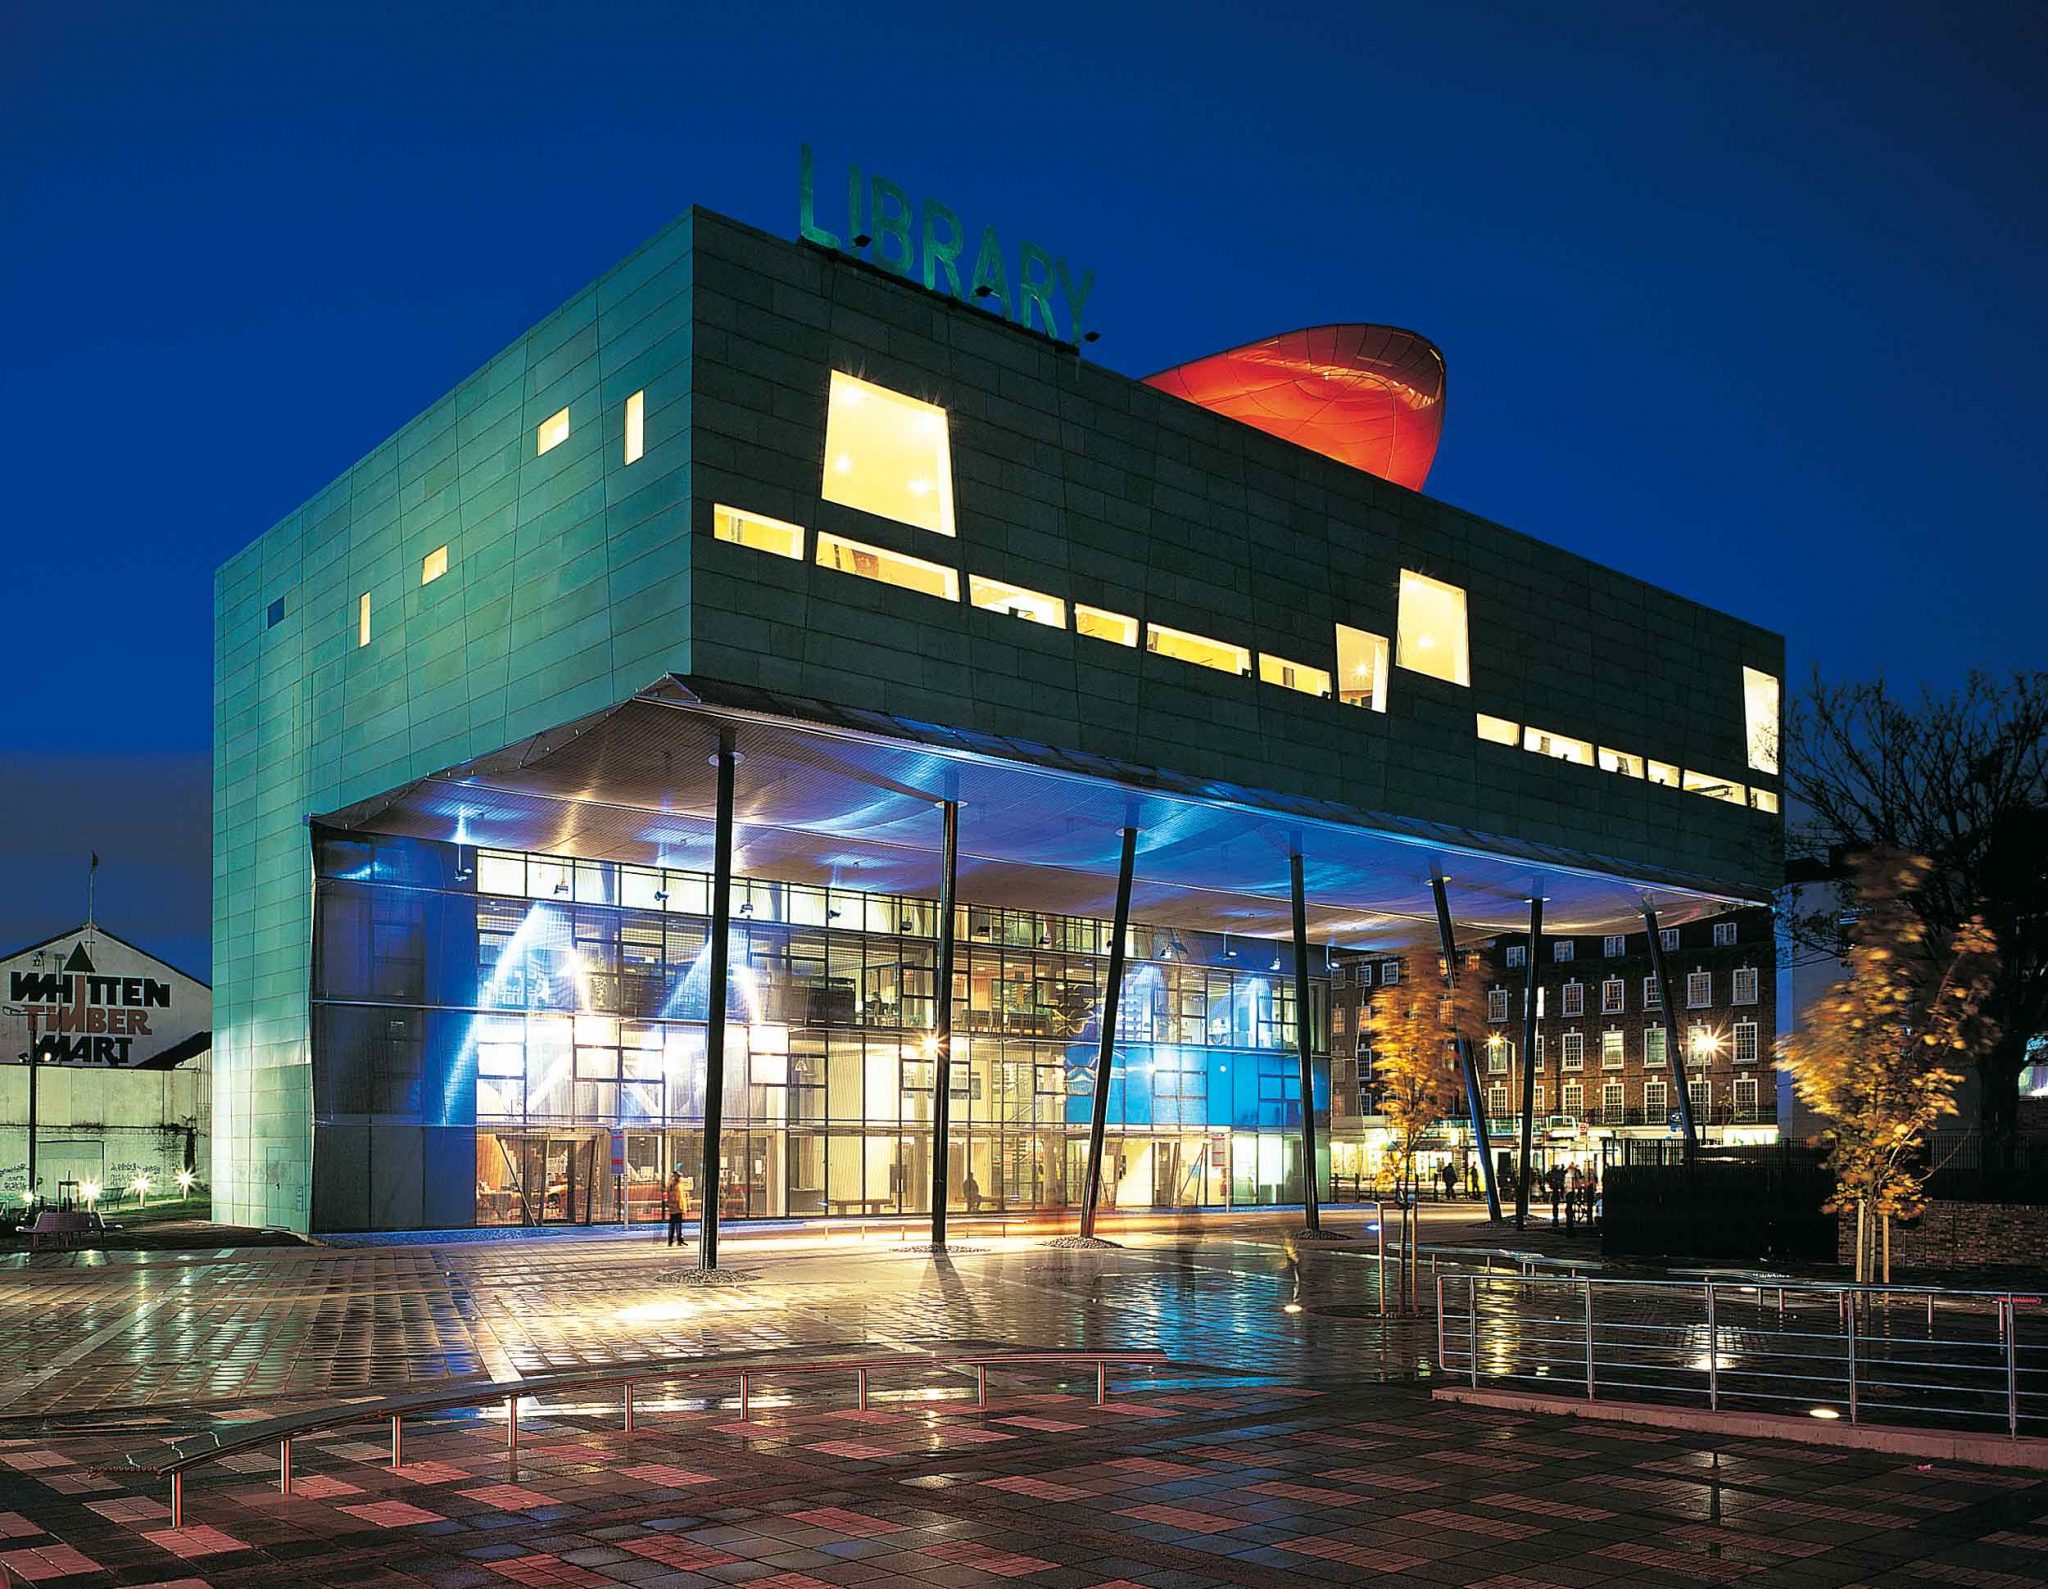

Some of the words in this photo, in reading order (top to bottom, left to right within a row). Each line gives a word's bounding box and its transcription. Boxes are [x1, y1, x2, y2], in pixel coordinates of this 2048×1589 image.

[800, 143, 1095, 345] LIBRARY
[10, 971, 171, 1007] WHITTEN
[22, 1004, 152, 1035] TIMBER
[36, 1035, 132, 1066] MART
